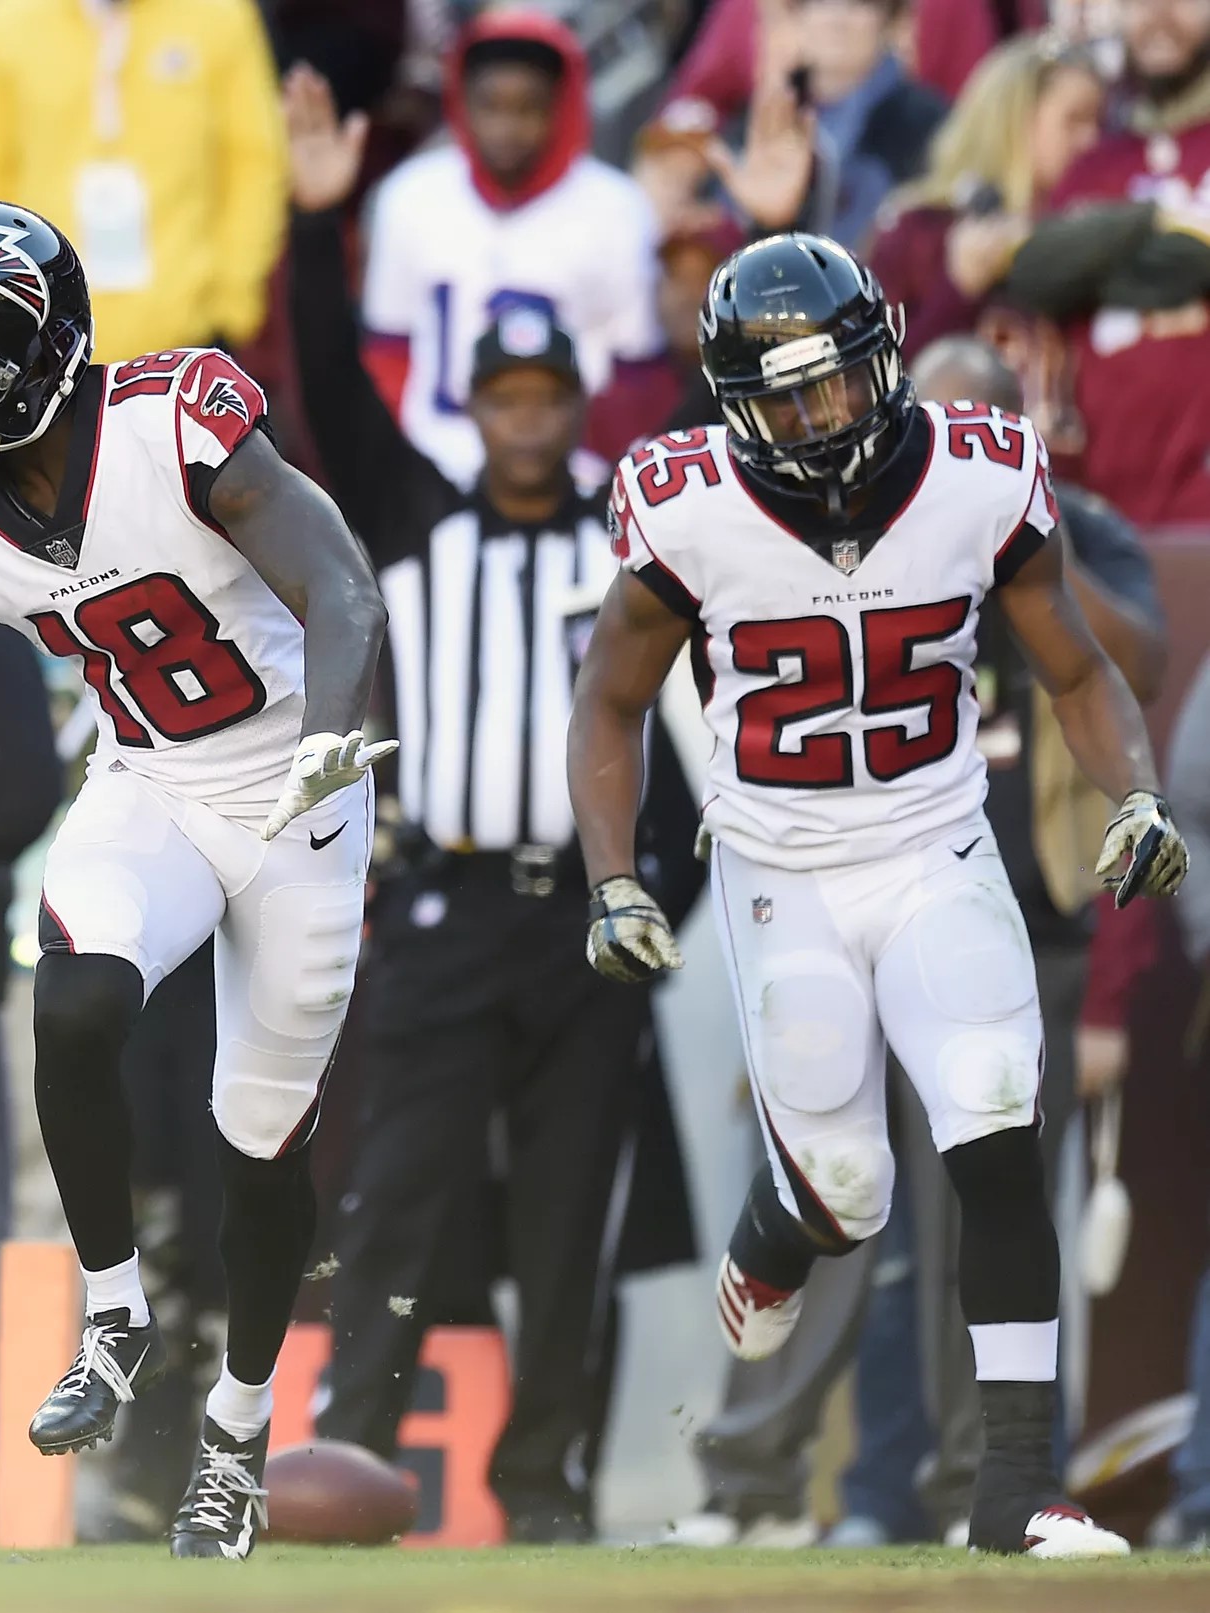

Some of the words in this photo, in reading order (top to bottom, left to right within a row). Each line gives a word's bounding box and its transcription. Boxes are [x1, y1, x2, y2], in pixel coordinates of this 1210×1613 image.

[49, 568, 120, 600] FALCONS
[812, 589, 894, 604] FALCONS
[24, 571, 267, 749] 18
[729, 594, 972, 790] 25
